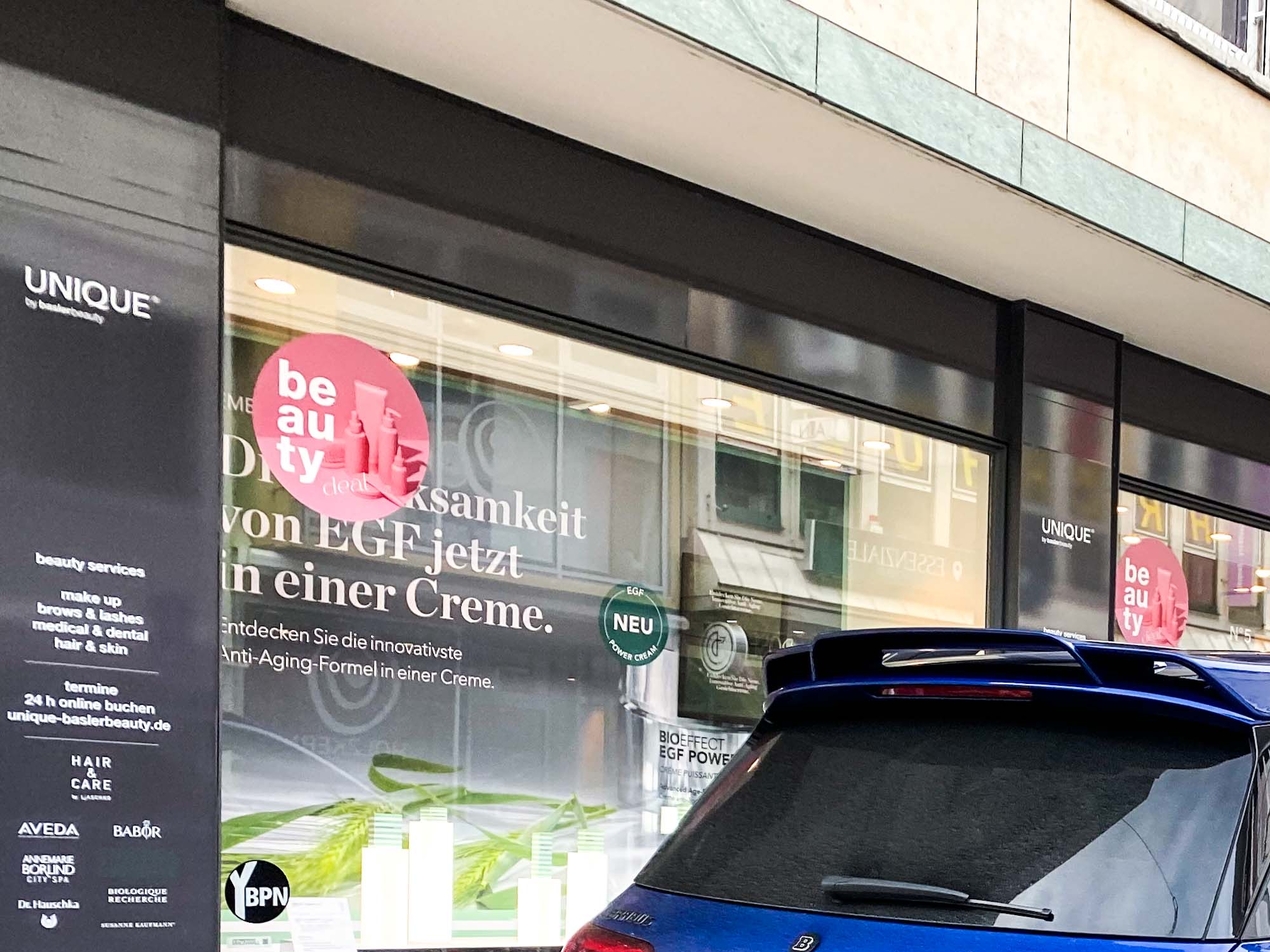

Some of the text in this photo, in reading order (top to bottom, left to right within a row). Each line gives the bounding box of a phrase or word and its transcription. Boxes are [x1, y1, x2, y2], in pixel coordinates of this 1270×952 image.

[278, 357, 337, 407] be
[276, 404, 335, 442] au
[276, 436, 325, 484] ty
[221, 433, 587, 540] Di ksamkeit
[221, 504, 524, 579] von EGF jetzt
[35, 552, 146, 578] beauty services
[1124, 557, 1150, 586] be
[60, 590, 122, 609] make up
[221, 549, 554, 634] in einer Creme.
[626, 586, 645, 597] EGF
[1123, 586, 1149, 609] au
[37, 601, 145, 626] brows & lashes
[613, 613, 654, 636] NEU
[1122, 606, 1144, 636] ty
[32, 620, 149, 642] medical & dental
[221, 617, 463, 661] Entdecken Sie die innovativste
[54, 636, 129, 656] hair & skin
[608, 639, 659, 662] POWER CREAM
[221, 645, 495, 690] Anti-Aging-Formel in einer Creme.
[64, 680, 119, 697] termine
[24, 693, 156, 715] 24 h online buchen
[7, 709, 172, 733] unique-baslerbeauty.de
[659, 730, 725, 751] BIOEFFECT
[71, 755, 113, 769] HAIR
[659, 745, 734, 766] EGF POWE
[86, 767, 97, 779] &
[71, 778, 113, 792] CARE
[17, 822, 80, 837] AVEDA
[113, 820, 162, 840] BABOR
[26, 875, 70, 884] CITY SPA
[107, 888, 168, 897] BIOLOGIQUE
[107, 896, 168, 904] RECHERCHE
[33, 899, 80, 910] Hauschka
